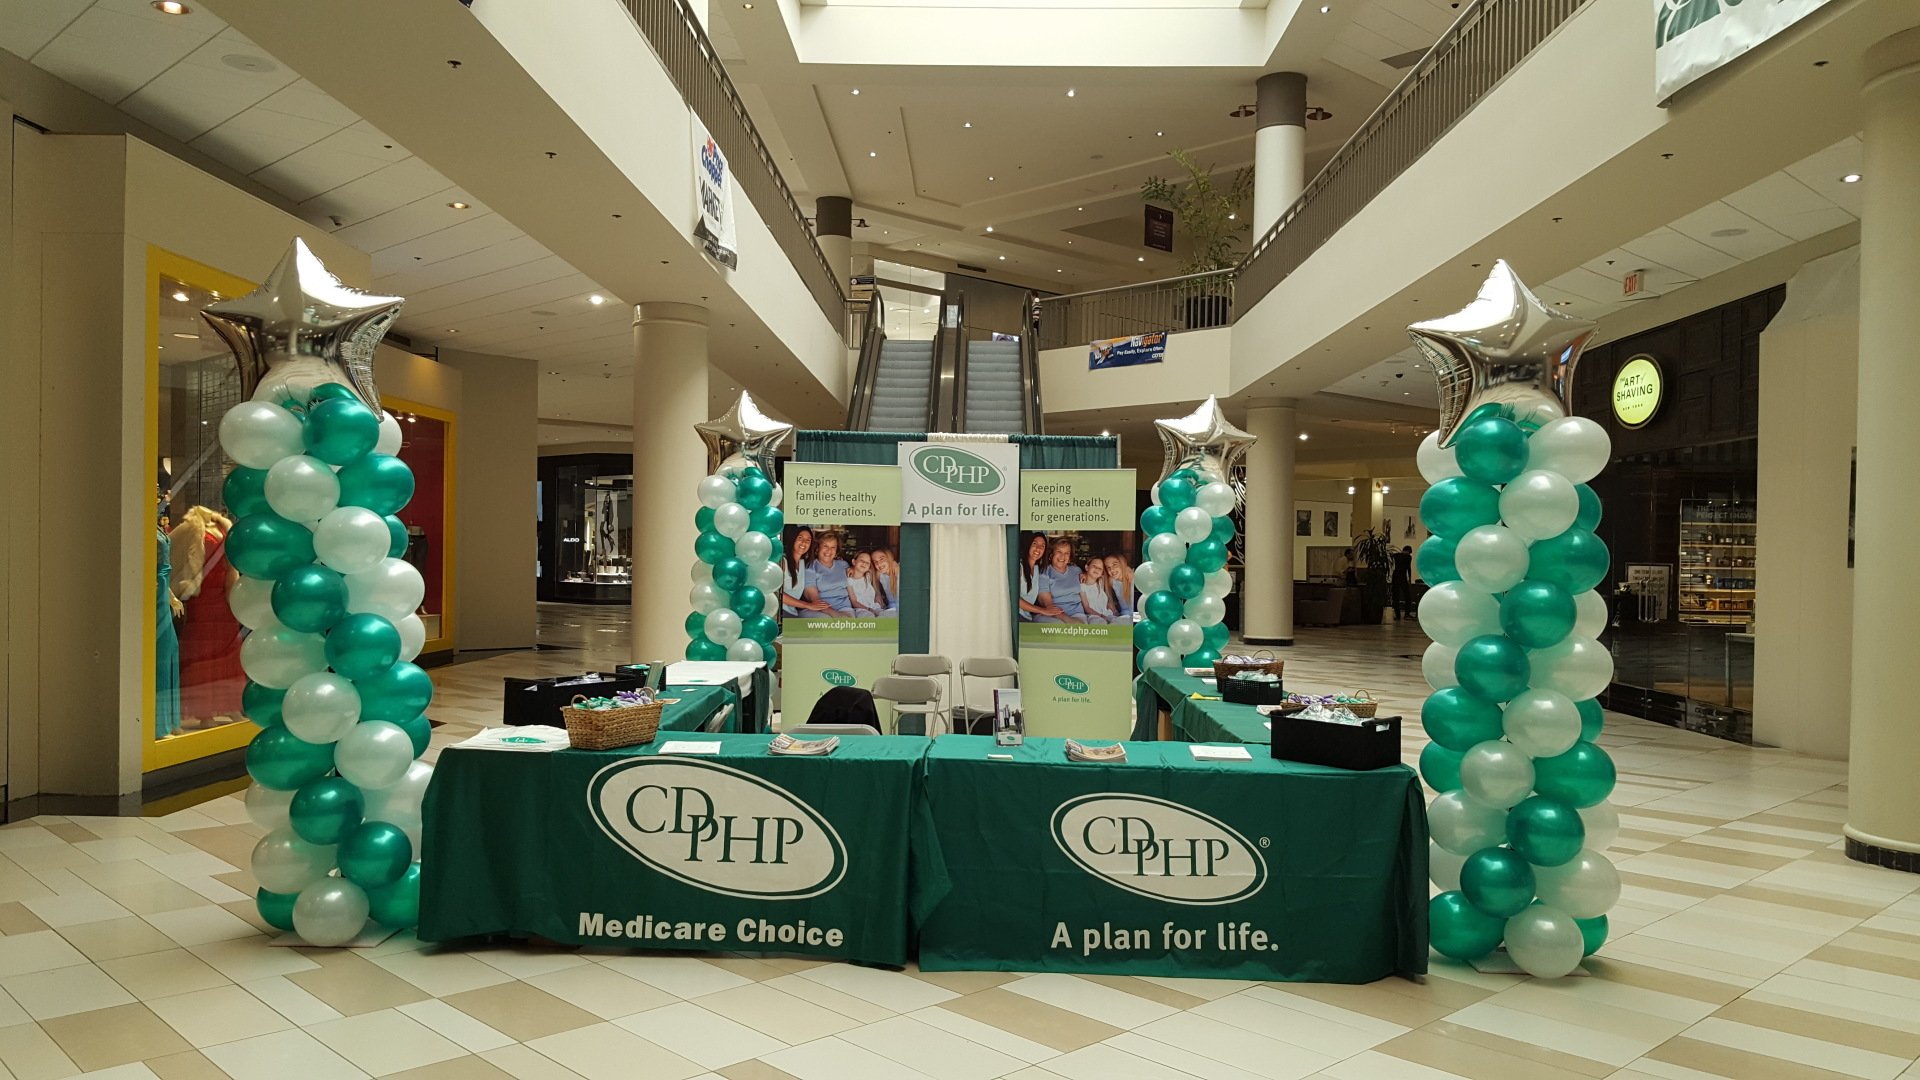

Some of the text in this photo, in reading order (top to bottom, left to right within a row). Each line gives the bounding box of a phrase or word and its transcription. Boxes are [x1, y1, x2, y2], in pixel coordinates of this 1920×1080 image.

[1130, 333, 1163, 348] Navigator
[1624, 374, 1641, 388] ART
[1616, 383, 1653, 402] SHAVING
[922, 455, 990, 484] CDPHP
[796, 476, 838, 489] Keeping
[1031, 483, 1072, 495] Keeping
[795, 490, 877, 505] families healthy
[1031, 497, 1110, 509] families healthy
[795, 505, 876, 518] for generations.
[907, 502, 1009, 518] A plan for life.
[1030, 511, 1109, 524] for generations.
[807, 620, 876, 631] www.cdphp.com
[1040, 625, 1108, 637] www.cdphp.com
[825, 671, 852, 684] CDPHP
[1058, 677, 1084, 690] CDPHP
[625, 784, 804, 865] CDPHP
[1082, 816, 1230, 877] CDPHP
[578, 912, 844, 947] Medicare Choice
[1050, 921, 1279, 957] A plan for life.
